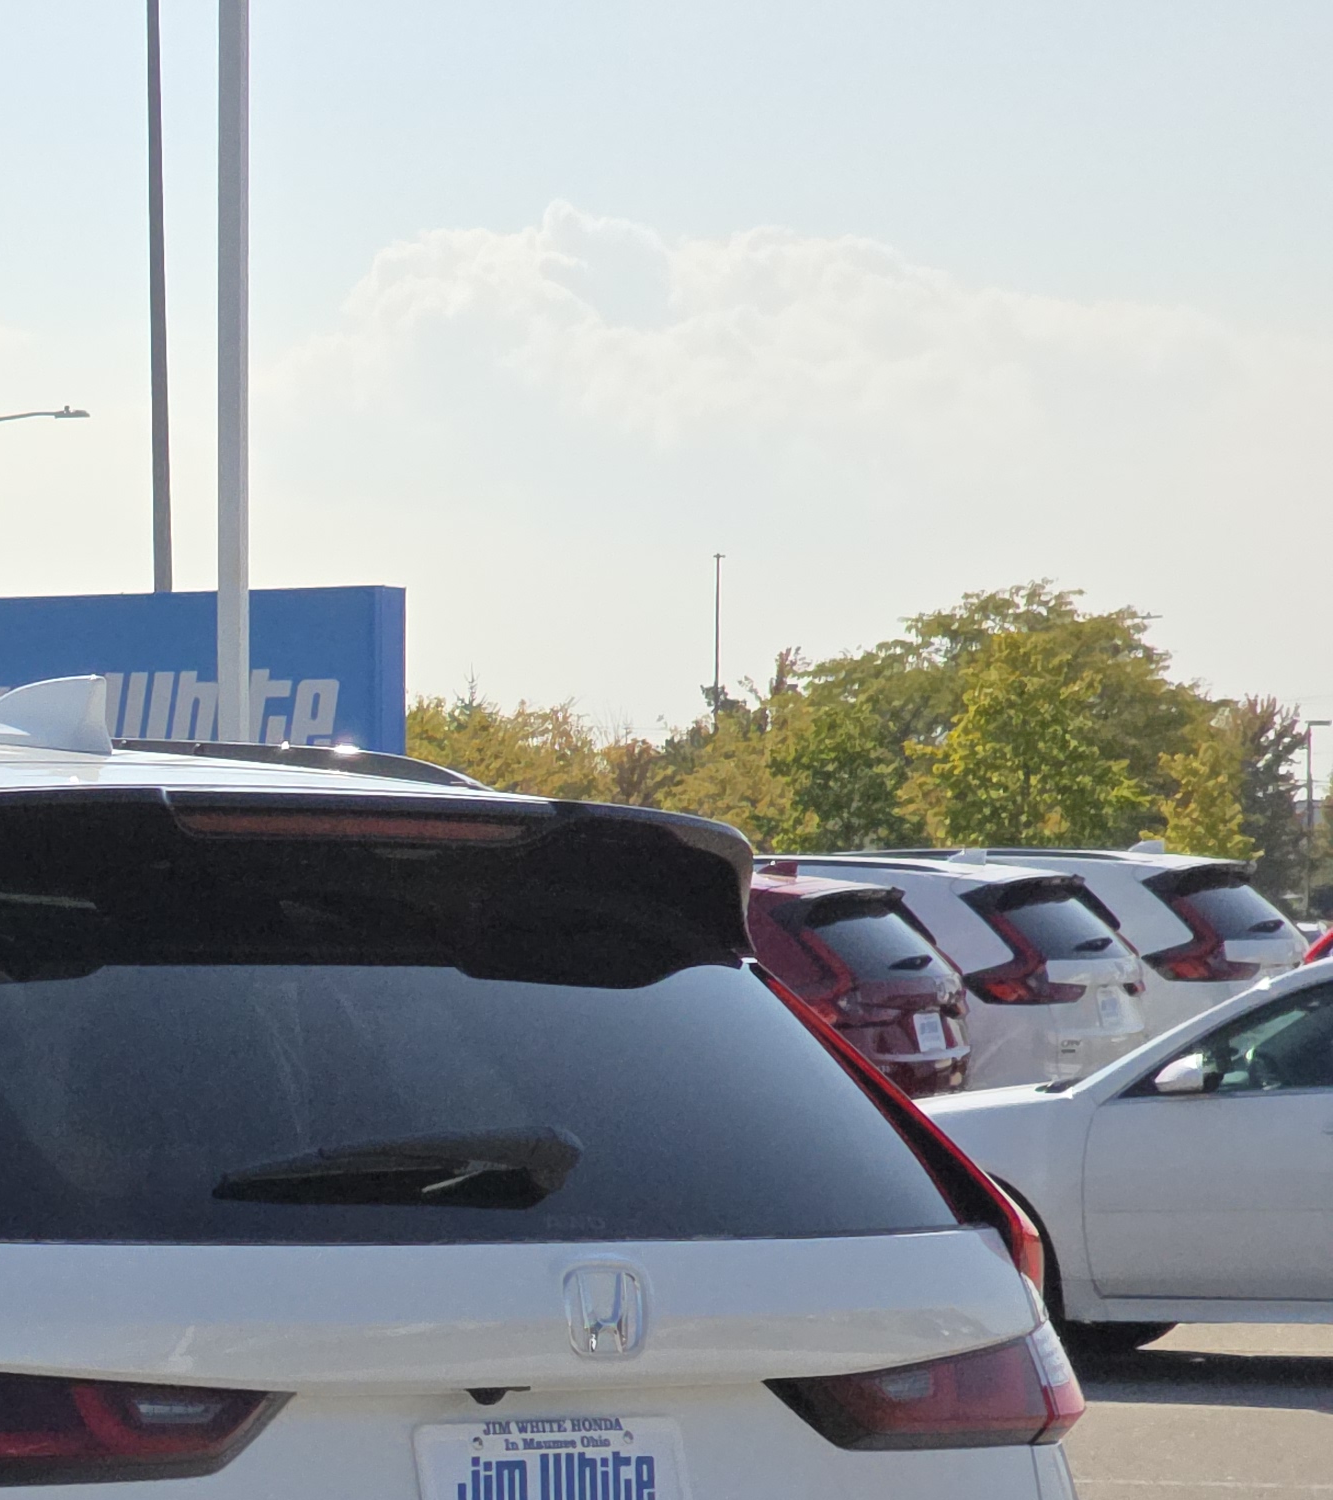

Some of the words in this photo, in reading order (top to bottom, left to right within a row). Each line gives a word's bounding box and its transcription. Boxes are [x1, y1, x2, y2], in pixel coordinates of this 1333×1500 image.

[104, 668, 340, 746] Whte
[483, 1420, 512, 1436] JIM
[515, 1418, 567, 1434] WHITE
[571, 1417, 624, 1432] HONDA
[504, 1438, 519, 1451] In
[580, 1434, 611, 1448] Ohio
